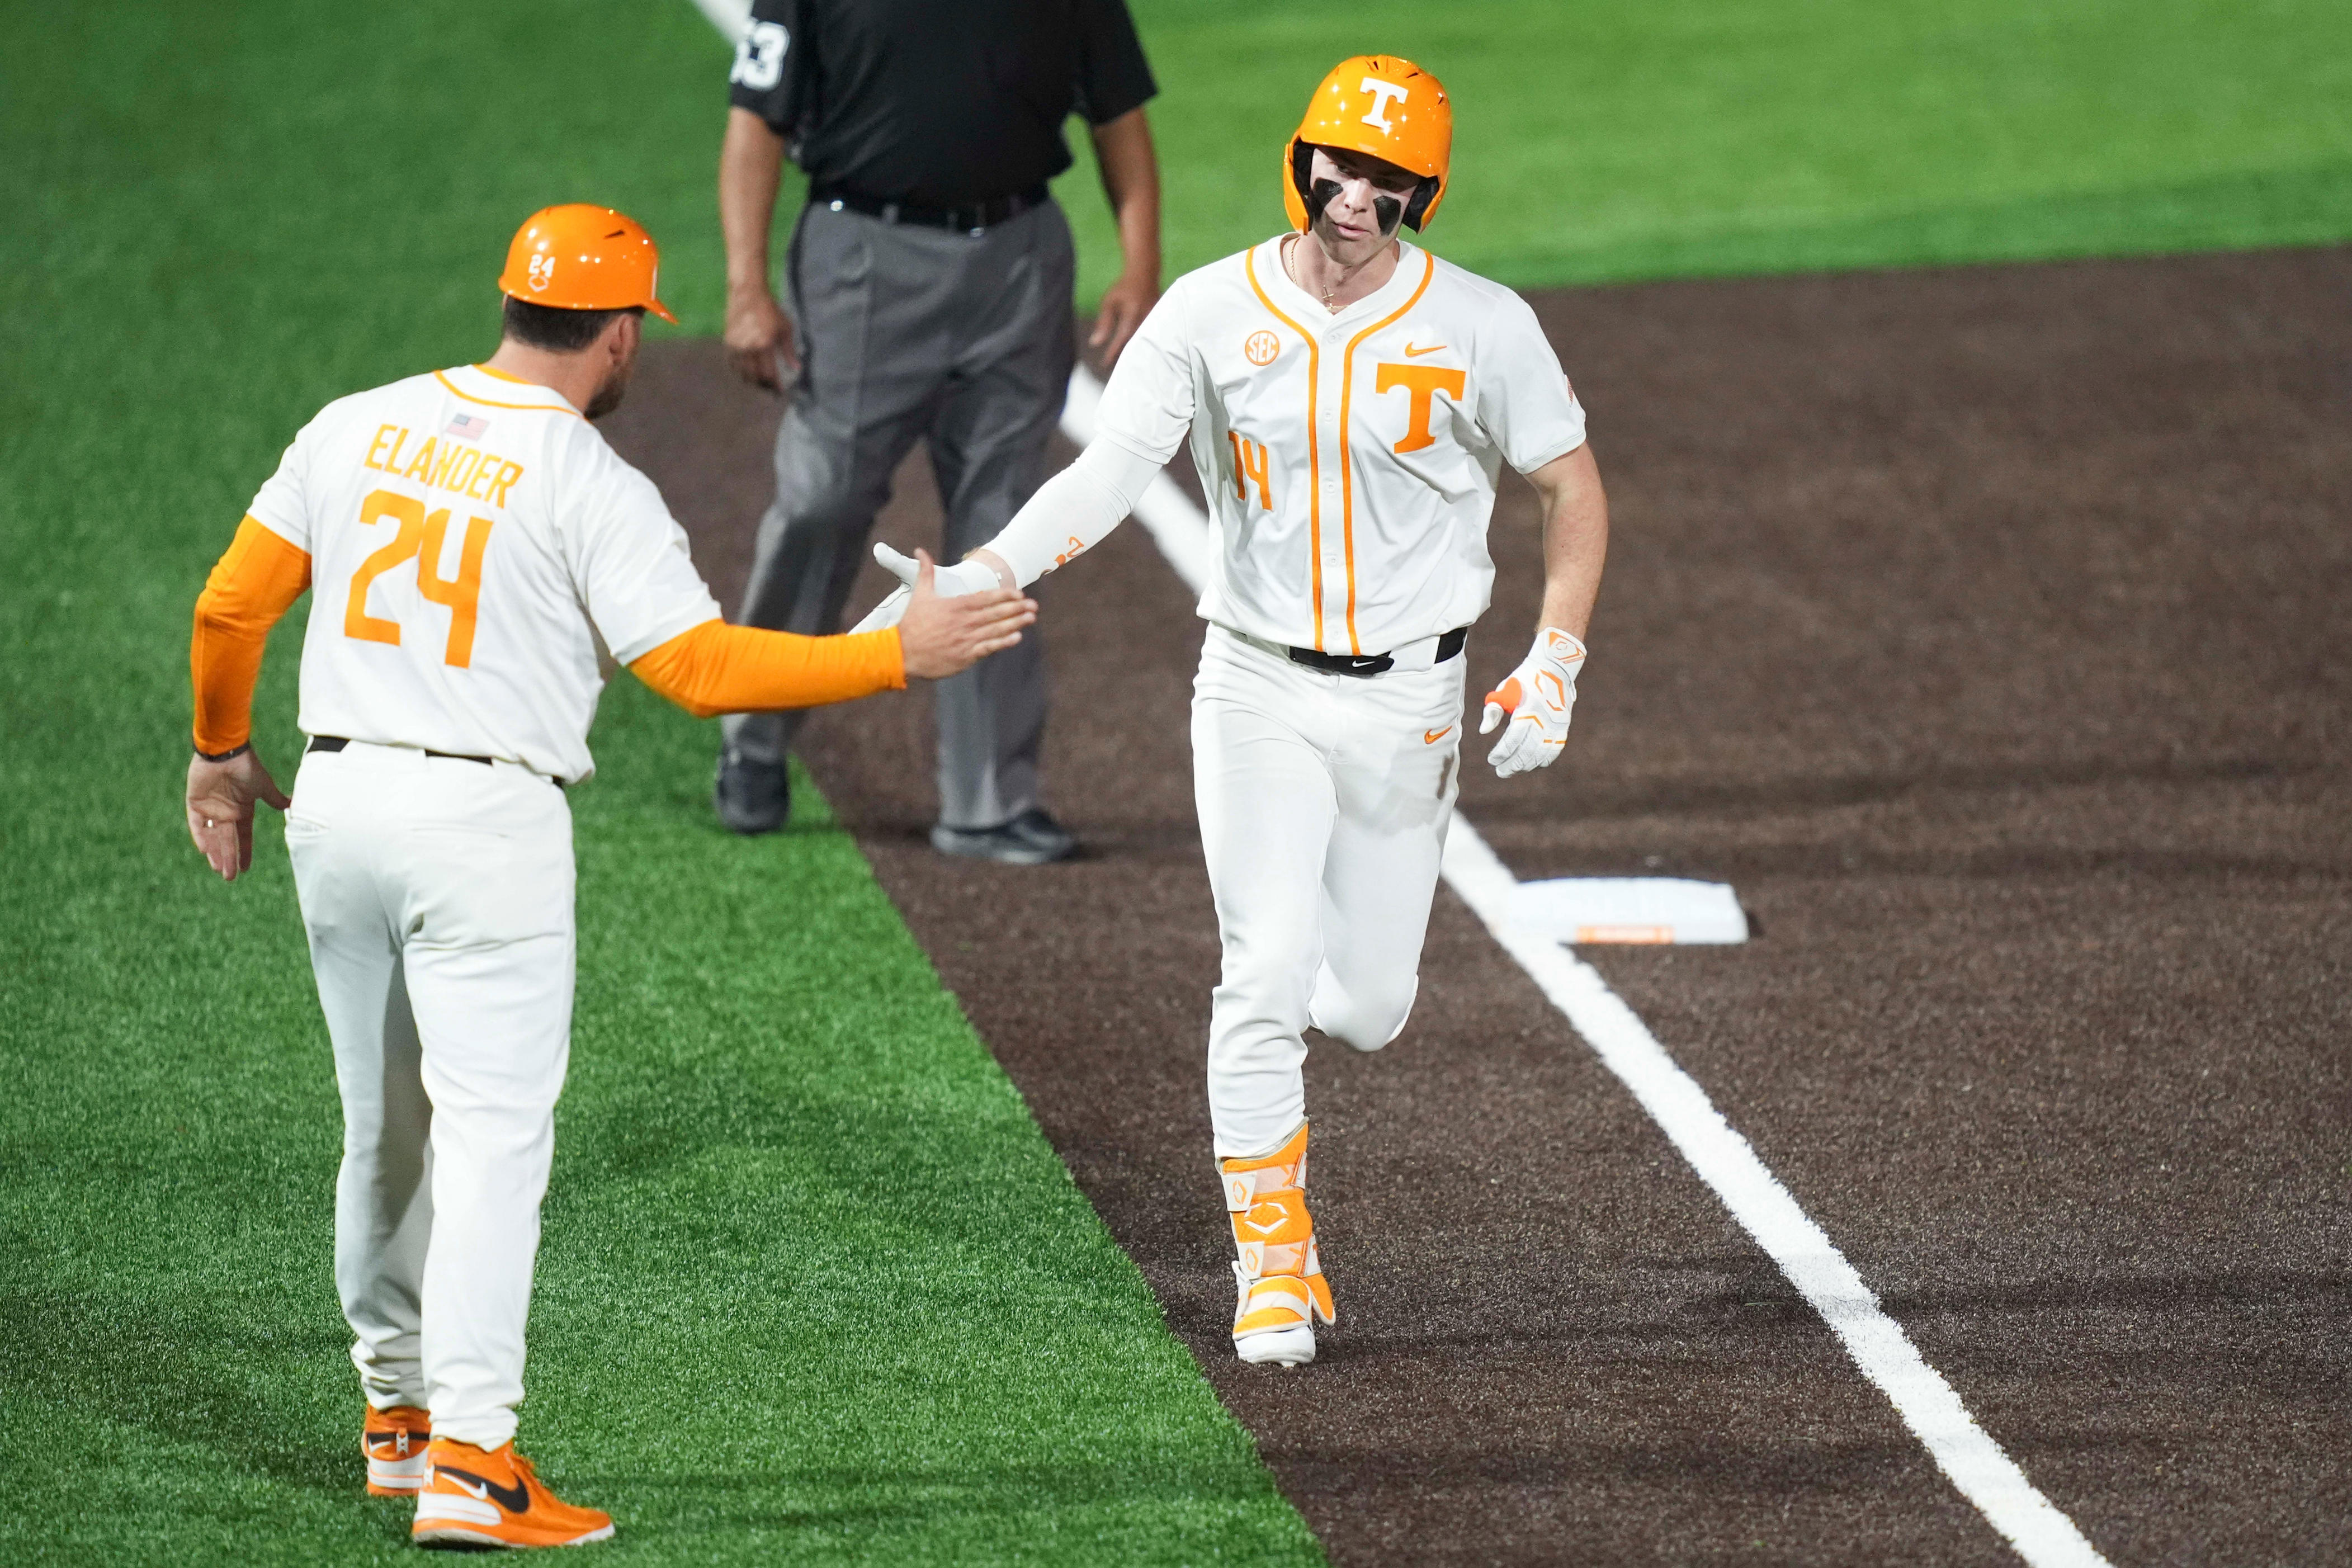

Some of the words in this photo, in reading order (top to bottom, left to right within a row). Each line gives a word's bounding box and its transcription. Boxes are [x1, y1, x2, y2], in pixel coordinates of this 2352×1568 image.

[1359, 77, 1409, 129] T
[528, 254, 556, 277] 24
[1248, 333, 1277, 362] SEC
[1376, 363, 1466, 454] T
[364, 423, 524, 509] ELANDER
[1228, 431, 1273, 511] 14
[344, 489, 494, 669] 24
